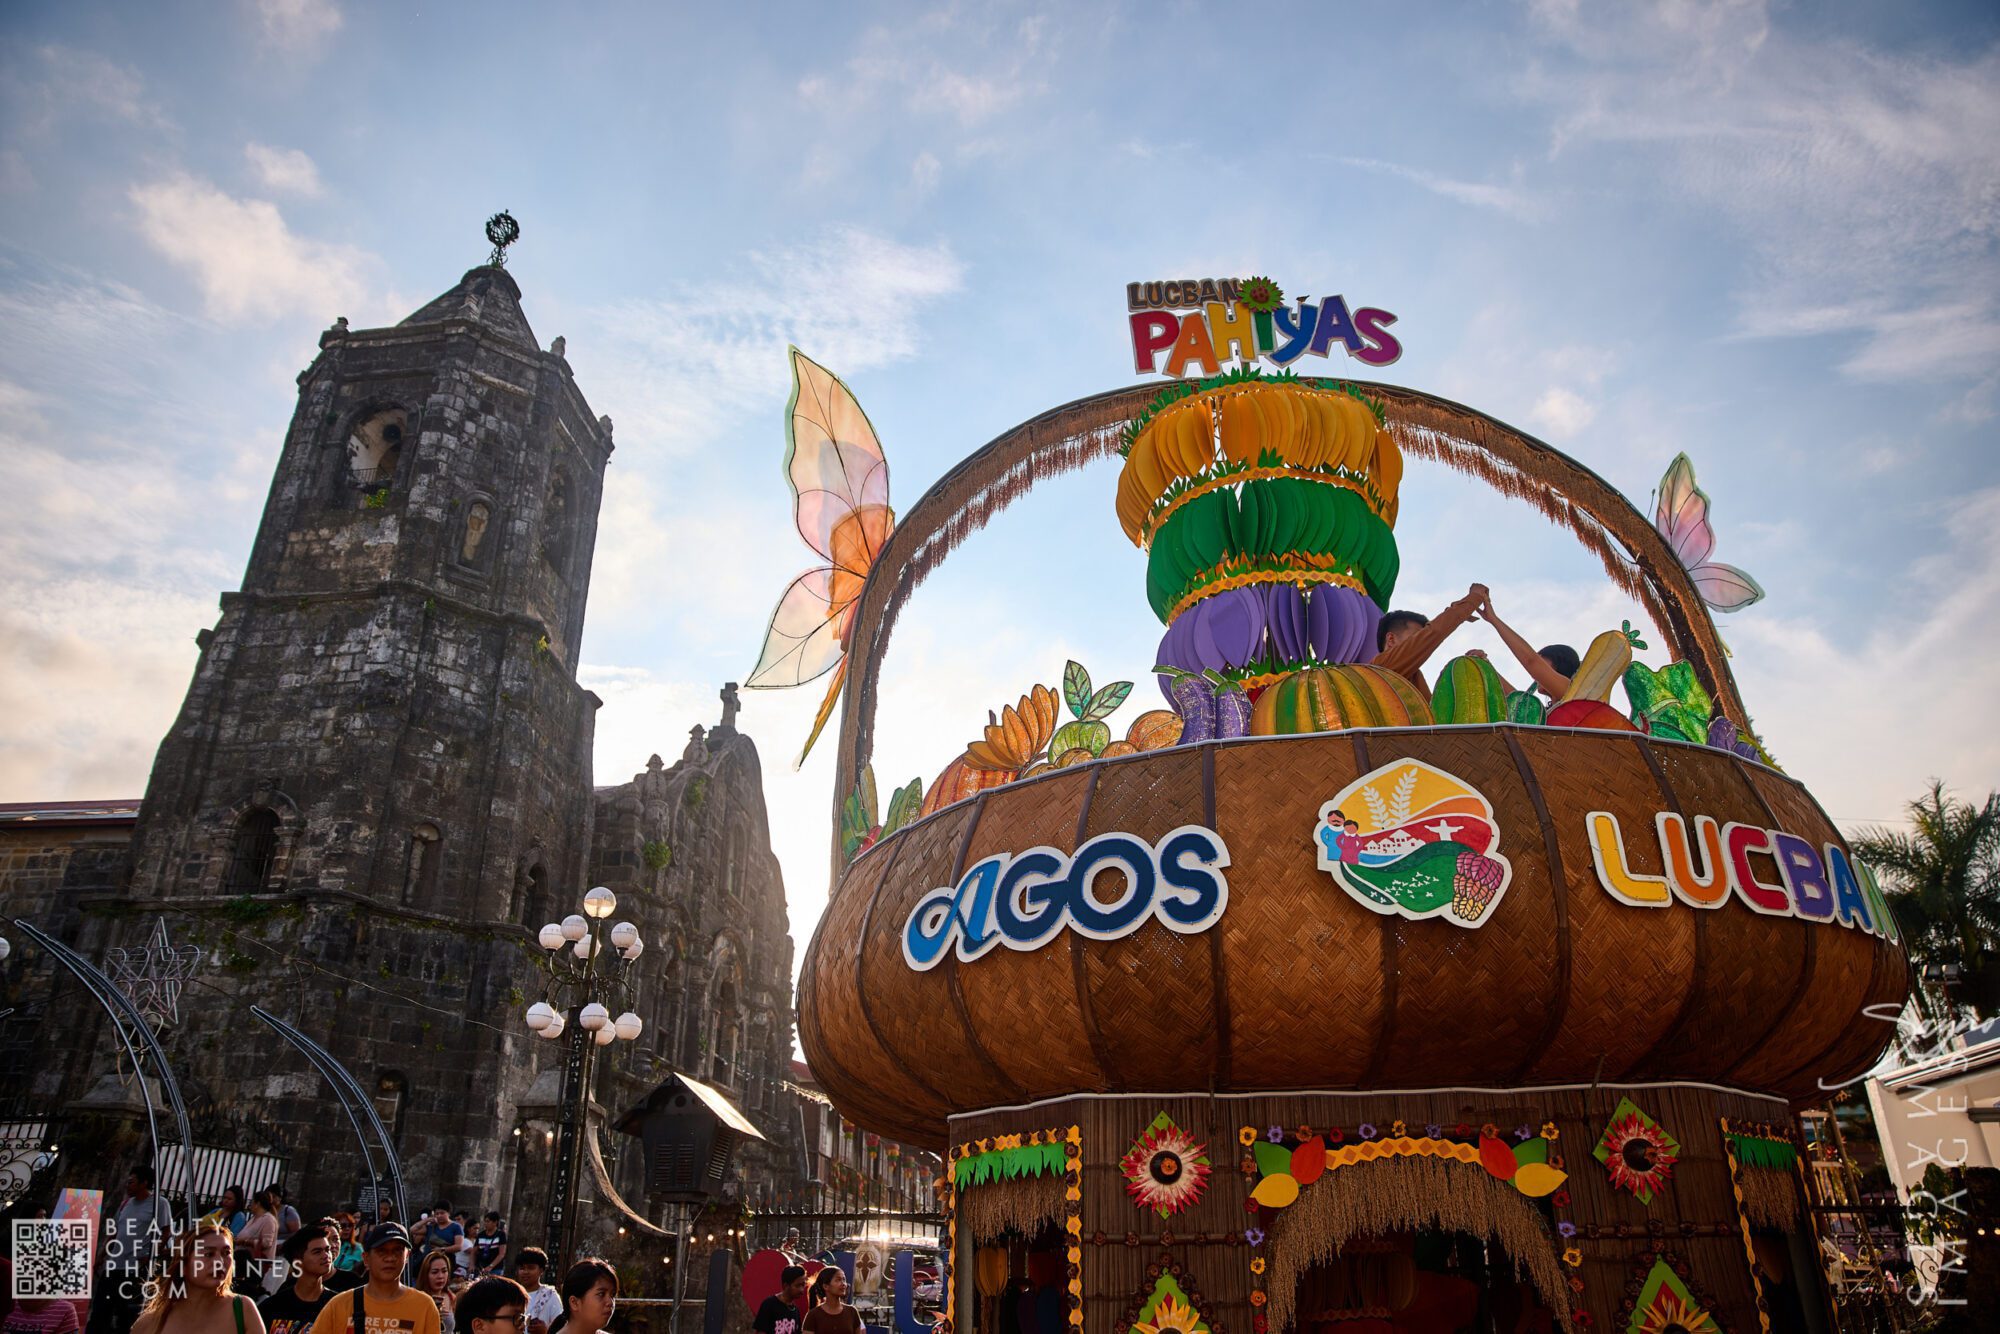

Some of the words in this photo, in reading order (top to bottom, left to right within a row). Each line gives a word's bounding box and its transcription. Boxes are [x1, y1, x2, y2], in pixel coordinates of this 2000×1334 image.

[1127, 278, 1240, 311] LUCBAN
[902, 825, 1230, 971] AGOS
[1586, 811, 1898, 945] LUCBAN
[347, 1317, 380, 1326] DRE
